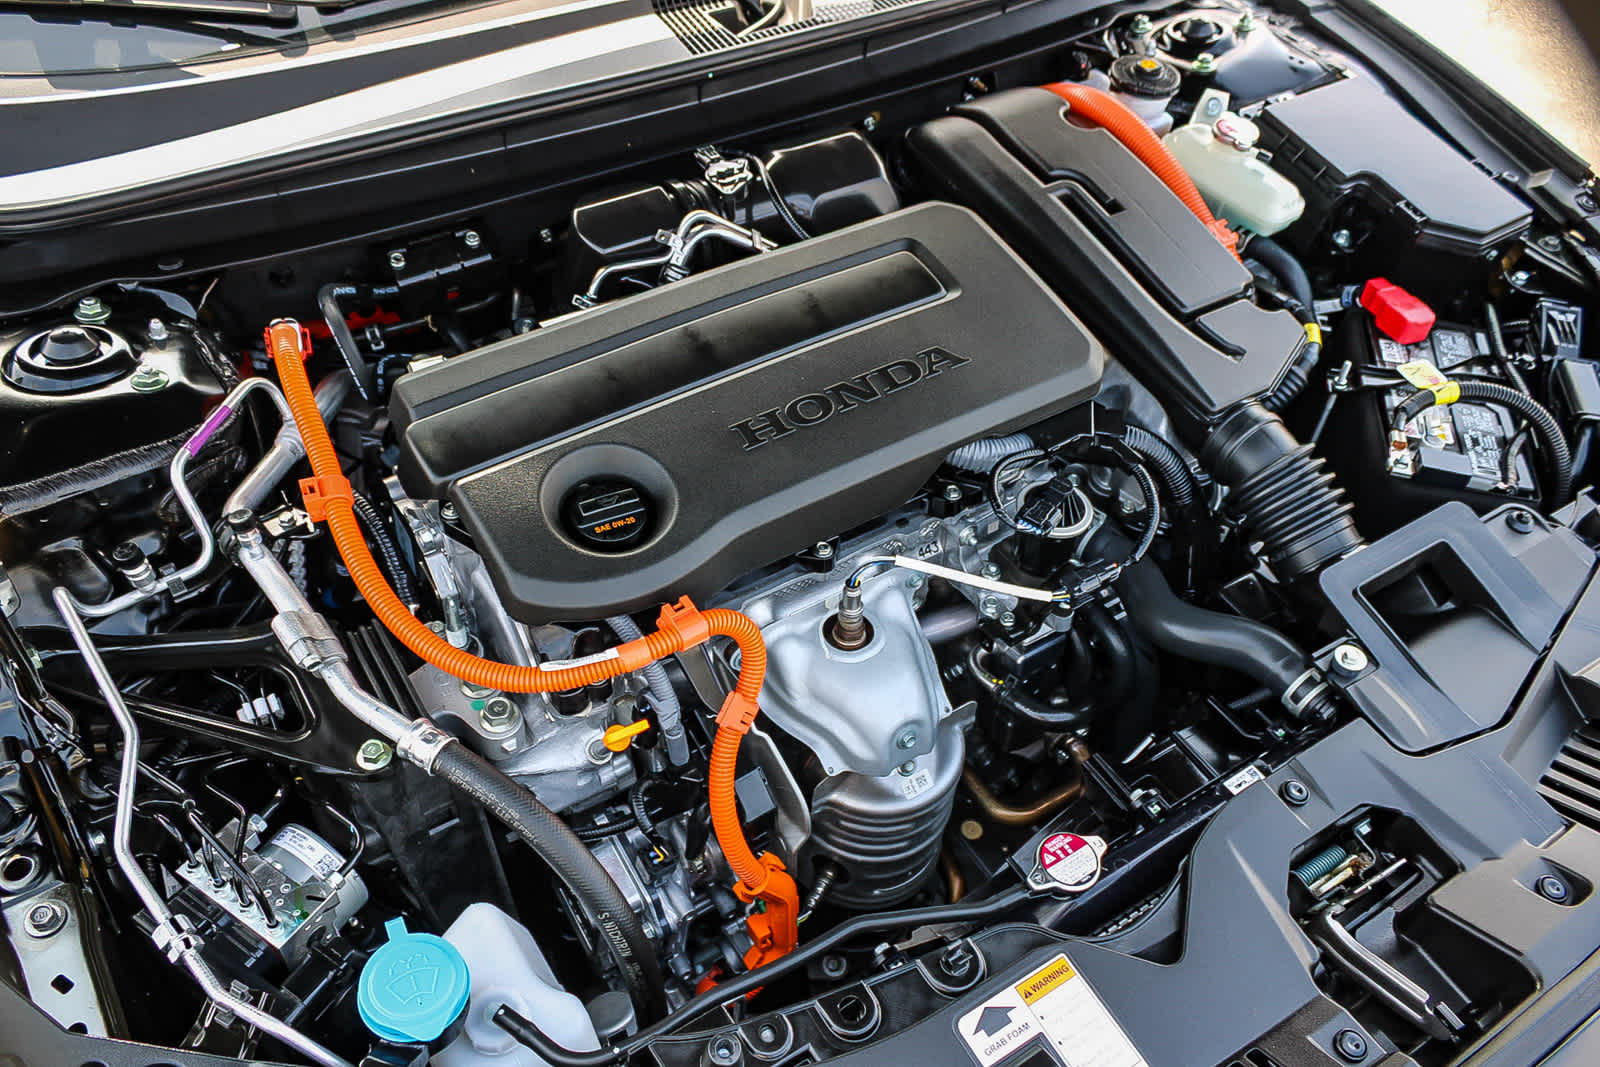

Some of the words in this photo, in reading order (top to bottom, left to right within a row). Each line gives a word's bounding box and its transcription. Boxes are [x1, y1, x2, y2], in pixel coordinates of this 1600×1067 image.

[728, 345, 973, 451] HONDA
[594, 523, 612, 534] SAE
[612, 516, 637, 529] 0W-20
[918, 541, 939, 556] 443
[1030, 964, 1070, 993] WARNING
[984, 1038, 1009, 1057] GRAB
[1008, 1022, 1032, 1042] FOAM
